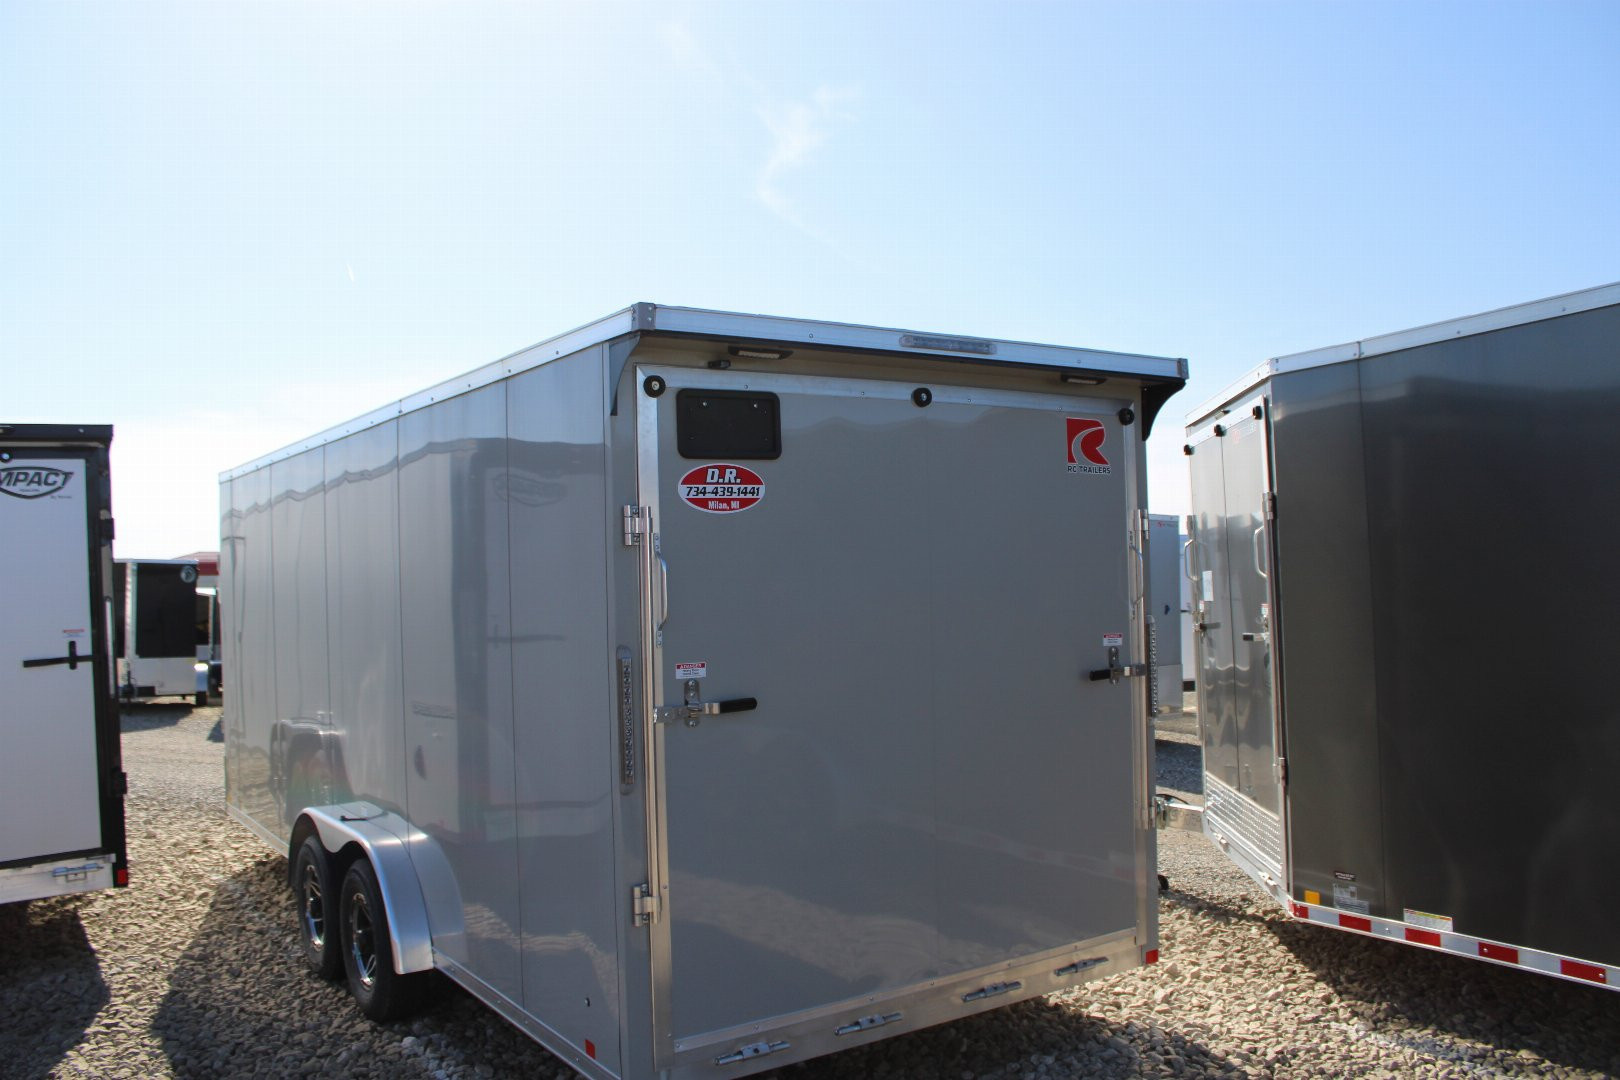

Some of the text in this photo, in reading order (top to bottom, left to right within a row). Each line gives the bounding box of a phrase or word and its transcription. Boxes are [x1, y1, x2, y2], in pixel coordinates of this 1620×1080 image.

[1067, 465, 1111, 474] RC TRAILERS
[706, 468, 741, 484] D.R.
[686, 486, 760, 497] 734-439-1441
[708, 500, 740, 510] Milan, MI
